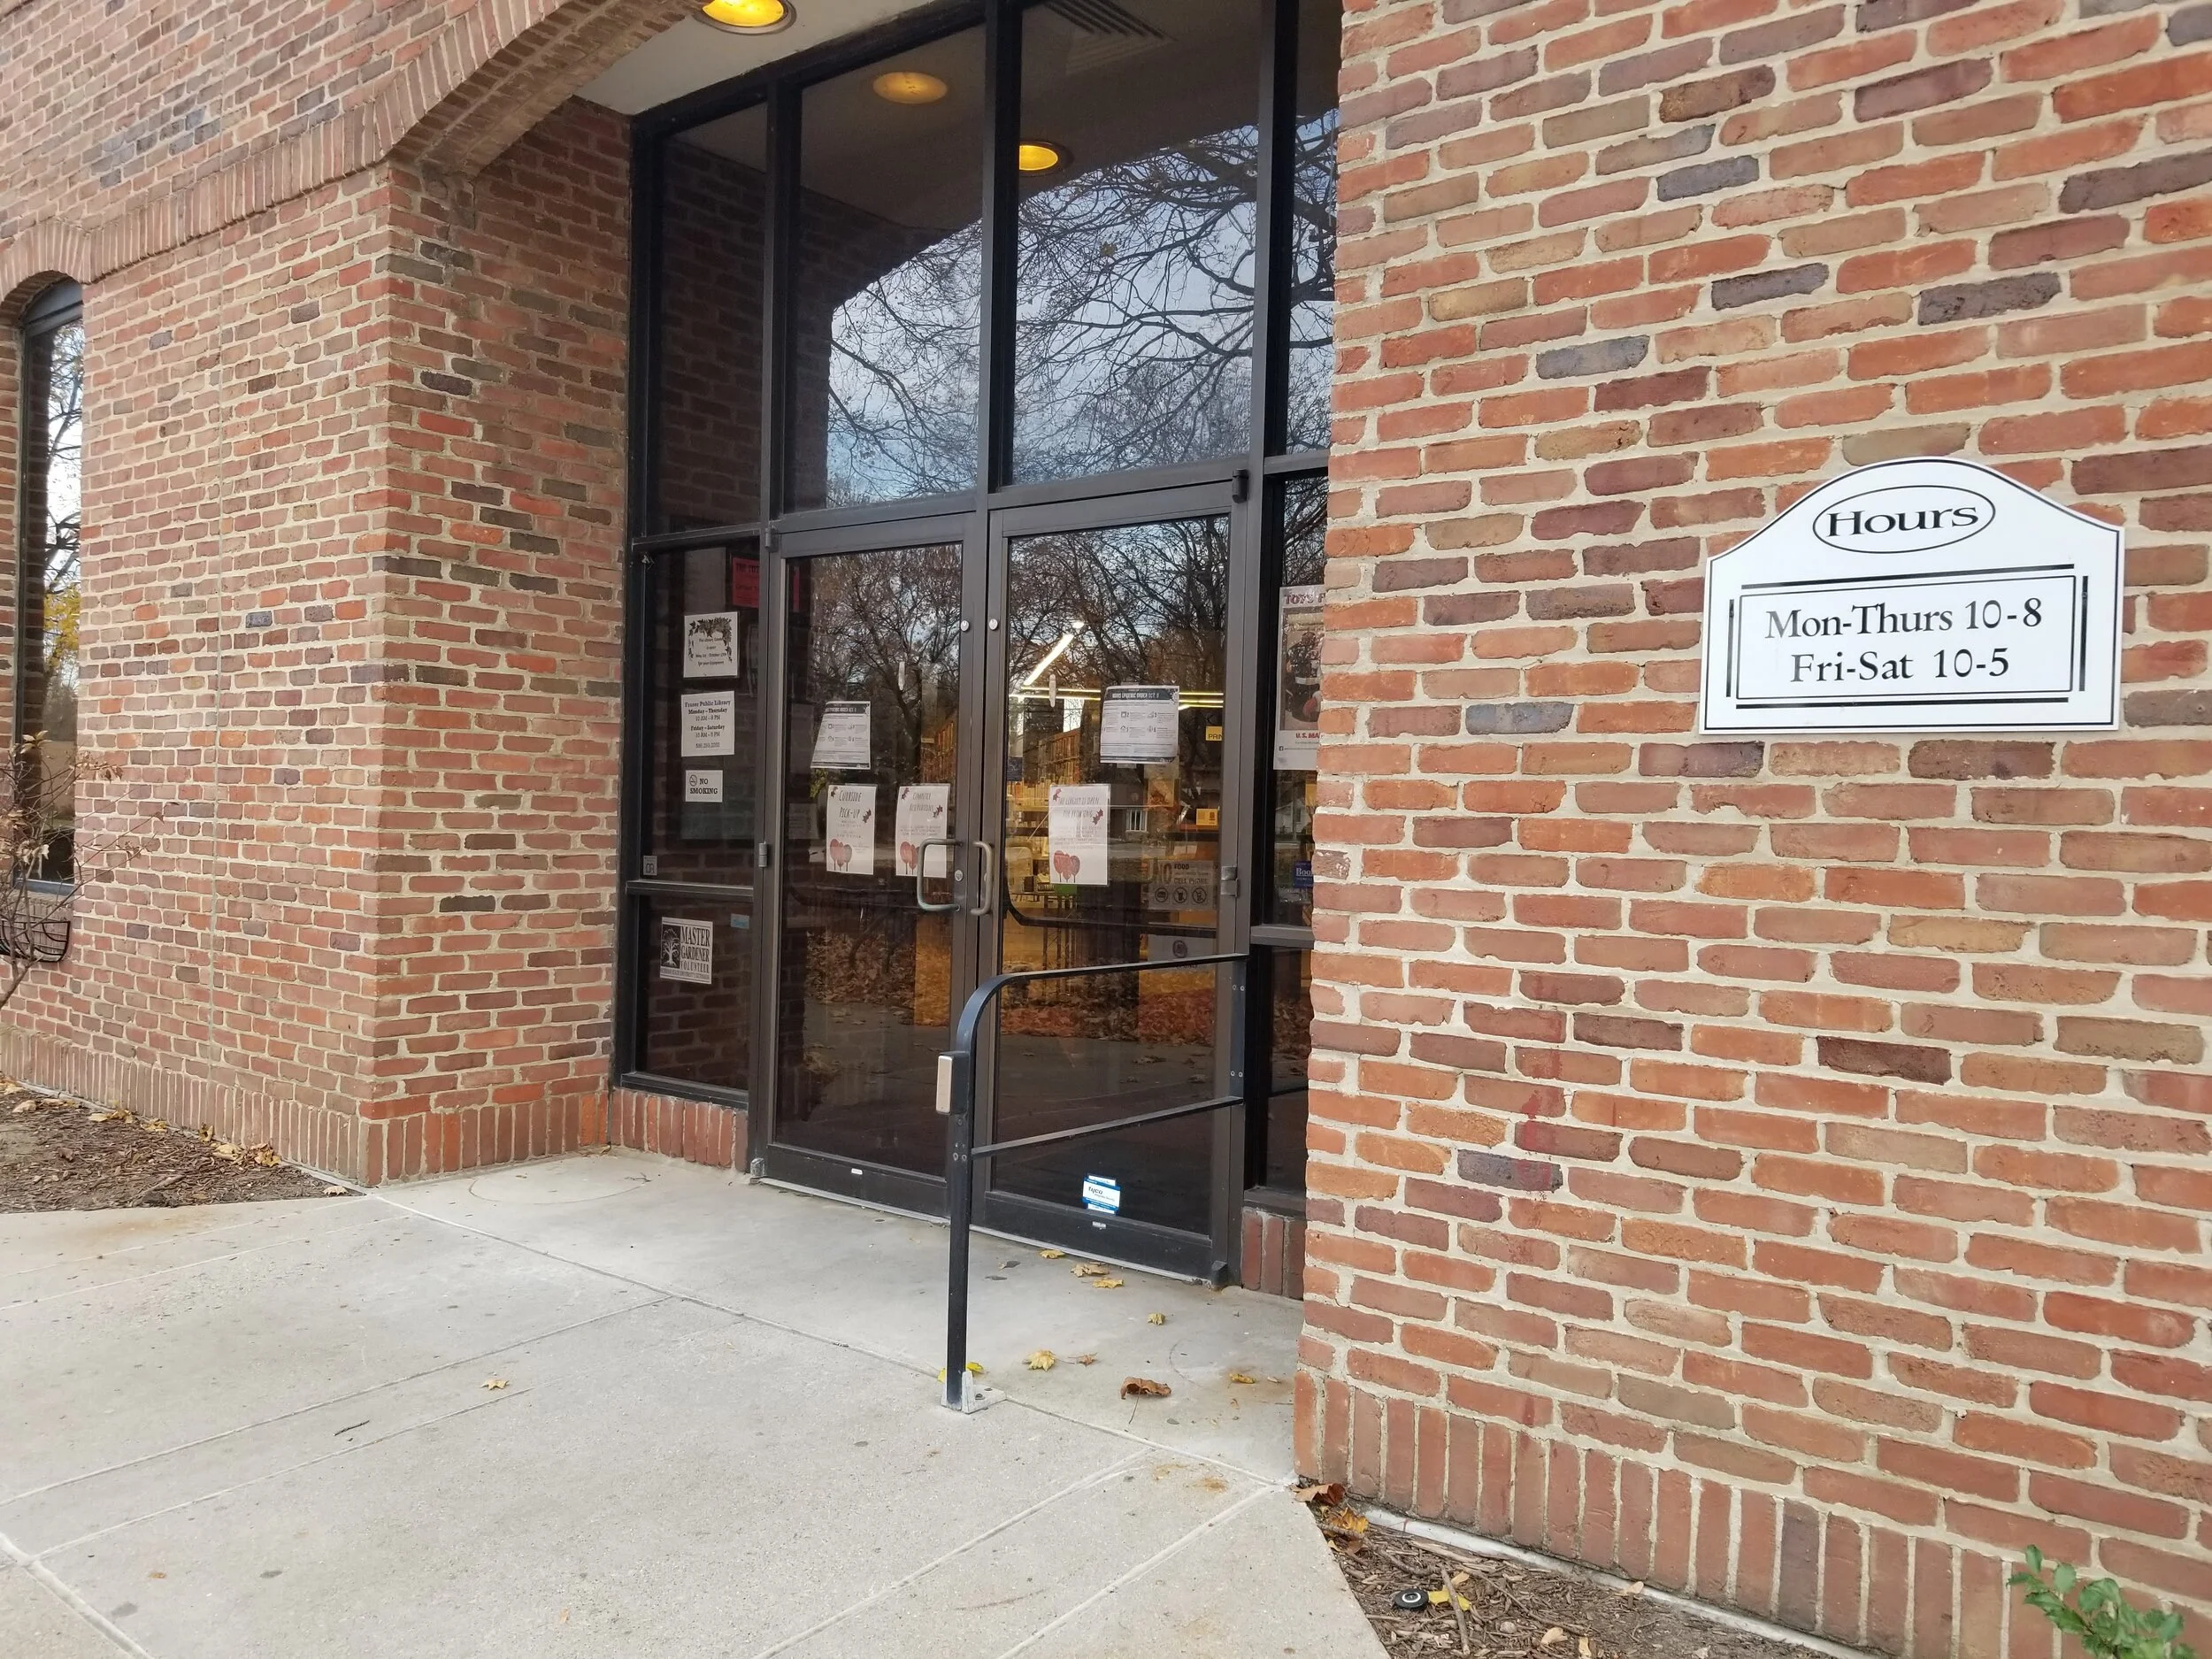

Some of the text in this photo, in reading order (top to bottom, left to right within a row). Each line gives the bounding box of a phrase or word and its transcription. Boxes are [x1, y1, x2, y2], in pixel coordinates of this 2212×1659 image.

[1826, 505, 1979, 538] Hours
[1284, 592, 1326, 604] TOYS F
[1764, 596, 2042, 640] Mon-Thurs 10-8
[1790, 648, 2009, 683] Fri-Sat 10-5
[839, 806, 861, 819] PICK-UP
[1295, 867, 1313, 877] Boo
[680, 926, 710, 947] MASTER
[680, 945, 710, 962] GARDENER
[1088, 1186, 1103, 1194] tyco
